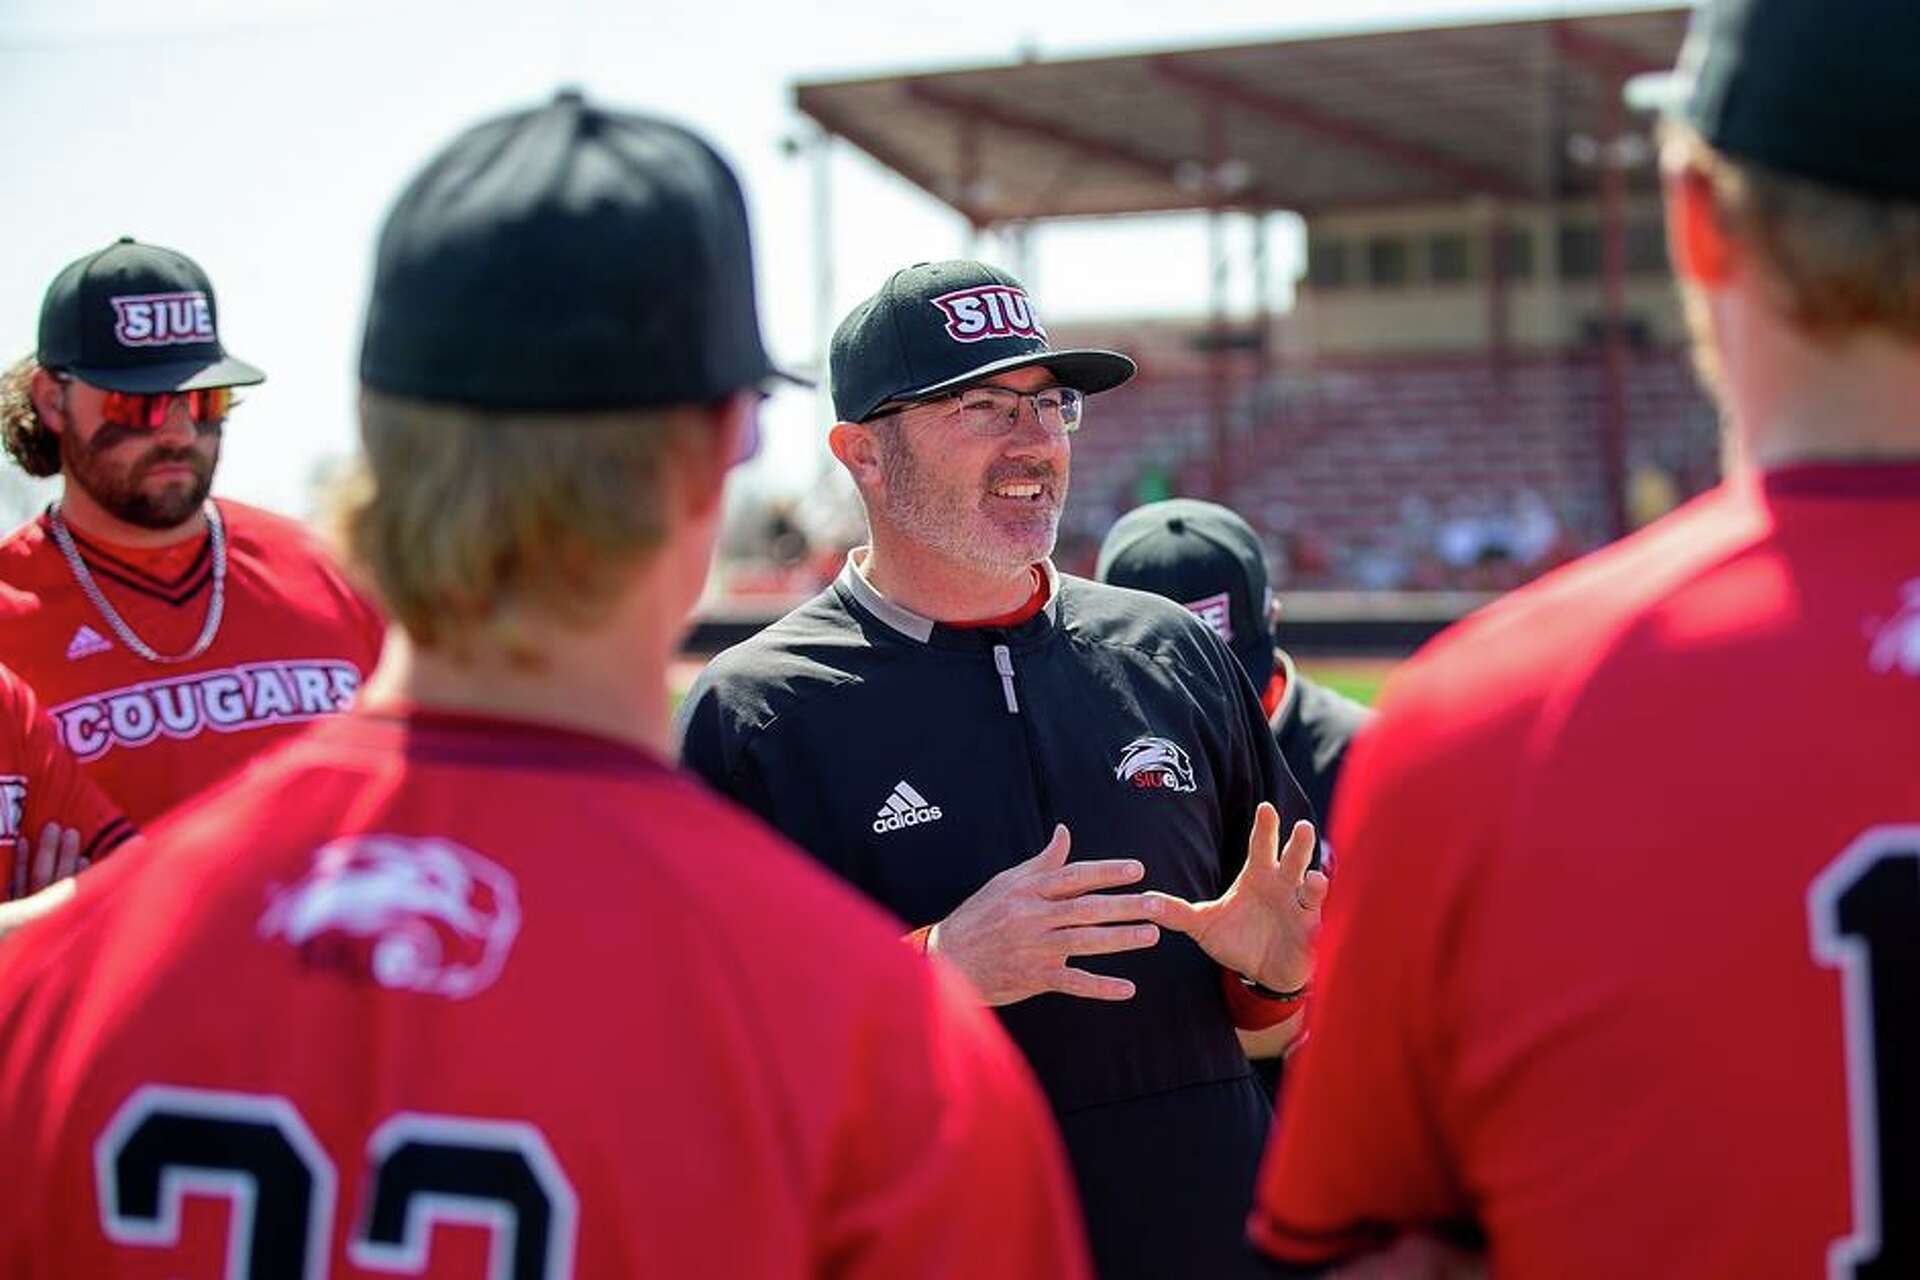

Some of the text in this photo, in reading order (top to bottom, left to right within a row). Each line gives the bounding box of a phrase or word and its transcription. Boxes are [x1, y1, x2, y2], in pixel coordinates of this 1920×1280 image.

[120, 297, 213, 341] SIUE
[58, 663, 359, 758] COUGARS
[873, 806, 943, 834] adidas
